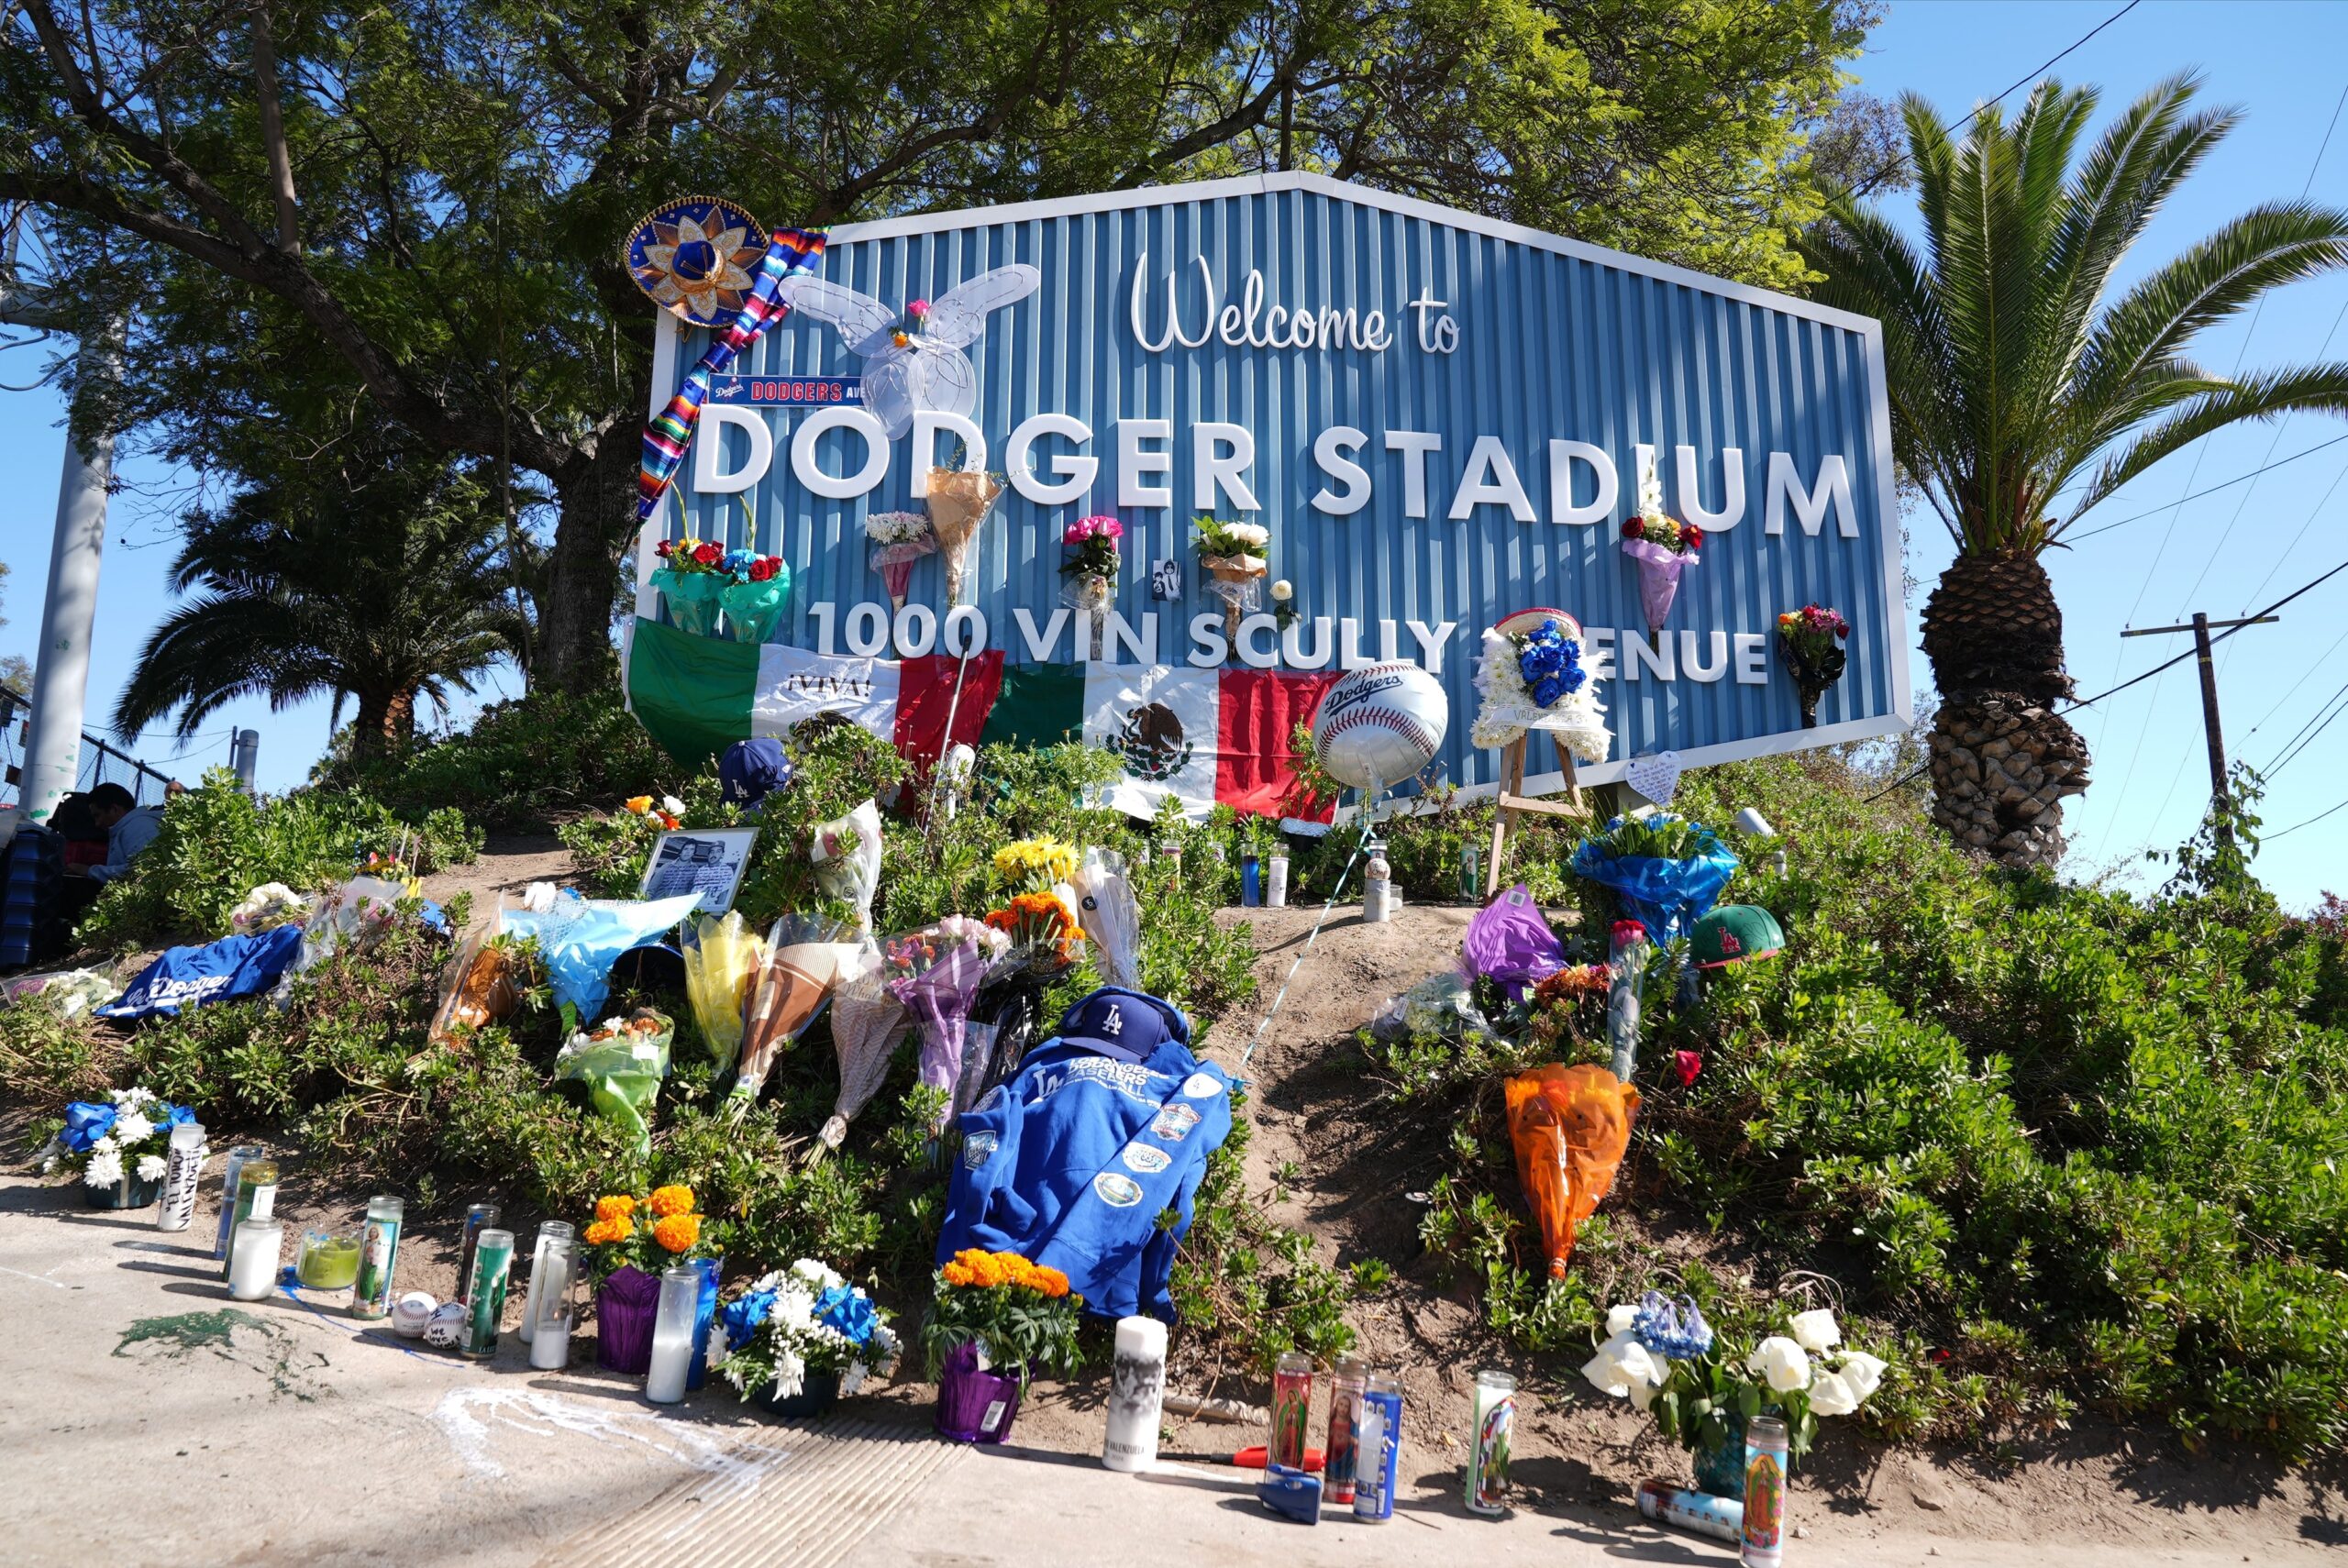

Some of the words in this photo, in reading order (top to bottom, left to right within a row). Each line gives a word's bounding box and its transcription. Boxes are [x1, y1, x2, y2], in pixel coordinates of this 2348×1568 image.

[1131, 251, 1392, 353] Welcome
[1409, 286, 1460, 354] to
[715, 382, 745, 398] Dodgers
[750, 381, 842, 402] DODGERS
[692, 403, 1262, 511] DODGER
[1311, 425, 1860, 539] STADIUM
[808, 602, 988, 659] 1000
[1013, 607, 1158, 664] VIN
[1187, 613, 1456, 674] SCULLY
[1583, 626, 1767, 686] ENUE
[788, 675, 870, 697] ¡VIVA!
[1324, 675, 1403, 719] Dodgers
[732, 779, 750, 799] LA
[1718, 926, 1741, 955] LA
[1102, 1004, 1123, 1035] LA
